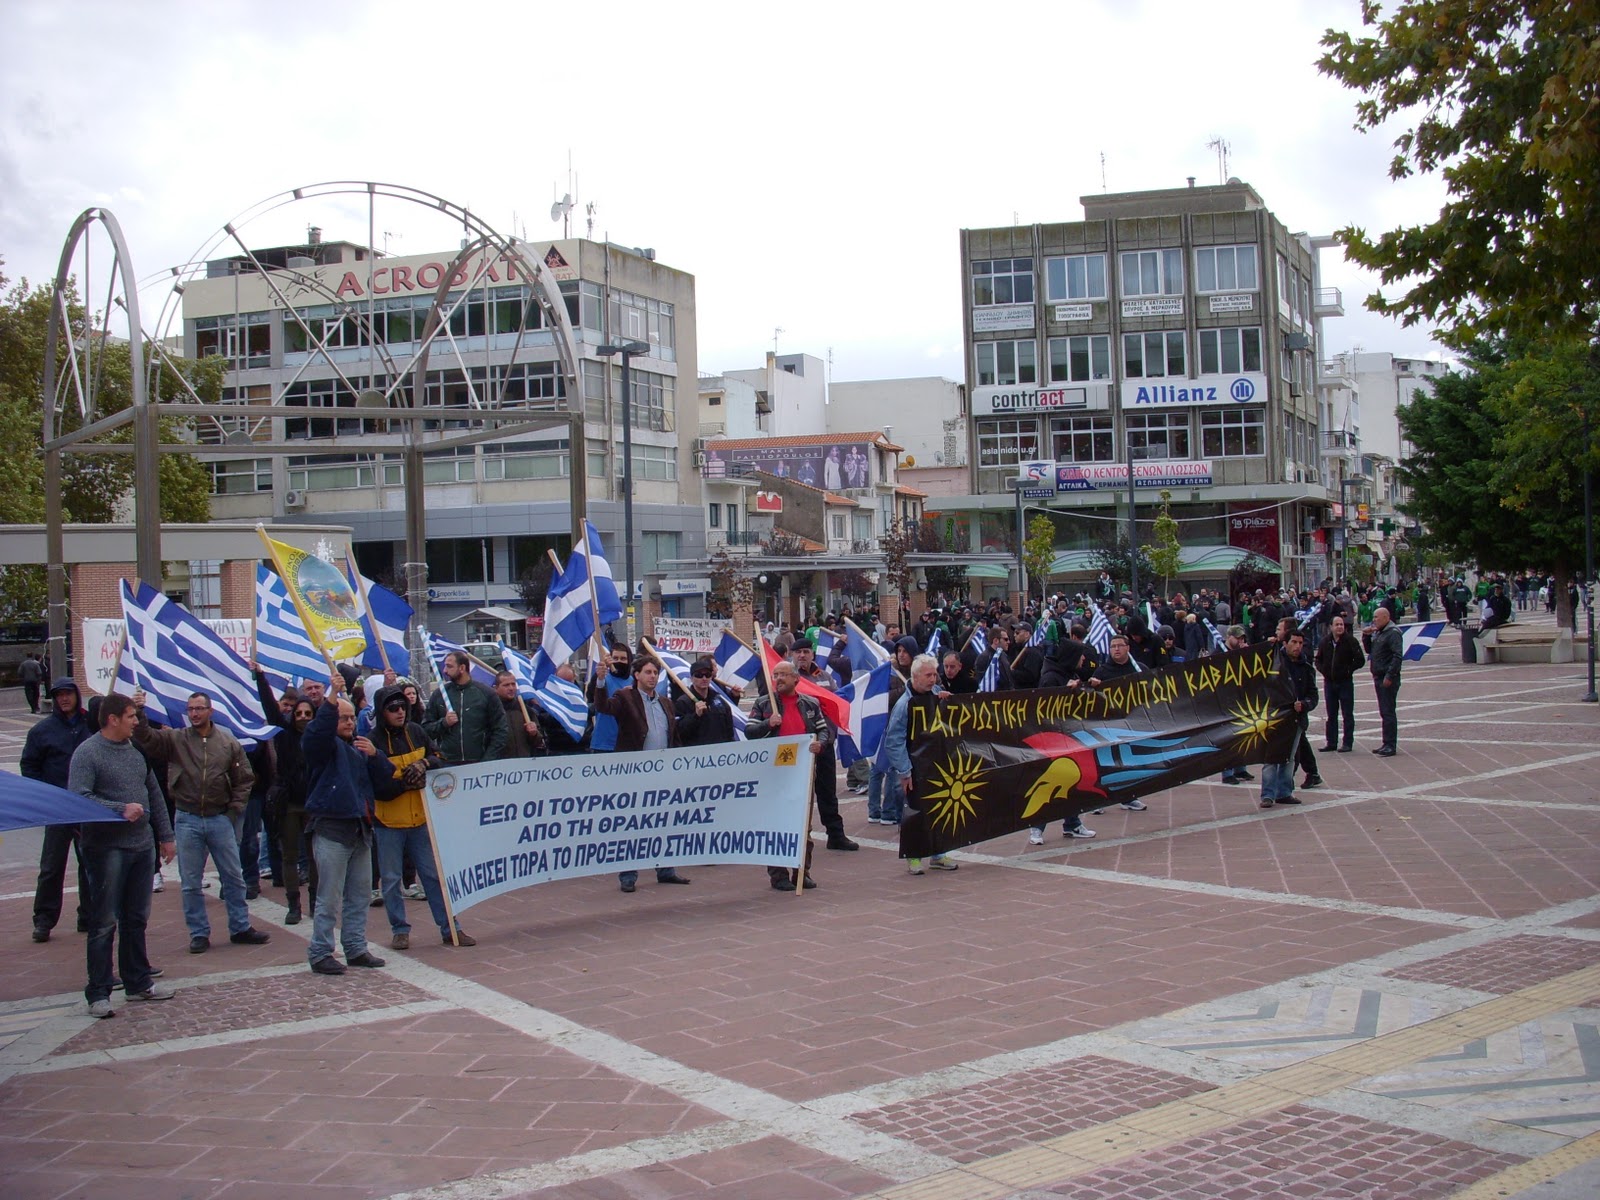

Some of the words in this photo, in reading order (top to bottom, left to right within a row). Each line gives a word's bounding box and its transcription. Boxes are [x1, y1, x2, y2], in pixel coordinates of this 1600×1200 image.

[336, 254, 524, 298] ACROBAT
[1136, 385, 1217, 405] Allianz
[1059, 482, 1087, 490] ΑΓΓΛΙΚΑ
[1093, 466, 1129, 478] ΚΕΝΤΡΟ
[1165, 463, 1208, 475] ΓΛΩΣΣΩΝ
[911, 699, 1029, 741] ΠΑΤΡΙΩΤΙΚΗ
[1037, 690, 1097, 726] ΚΙΝΗΣΗ
[1103, 675, 1179, 718] ΠΟΛΙΤΩΝ
[1184, 648, 1280, 697] ΚΑΒΑΛΑΣ
[479, 802, 518, 826] ΕΞΩ
[522, 799, 544, 819] ΟΙ
[549, 791, 637, 816] ΤΟΥΡΚΟΙ
[641, 780, 759, 808] ΠΡΑΚΤΟΡΕΣ
[517, 821, 562, 845] ΑΠΟ
[567, 818, 594, 838] ΤΗ
[598, 810, 670, 833] ΘΡΑΚΗ
[673, 806, 717, 828] ΜΑΣ
[446, 874, 461, 904] ΝΑ
[459, 857, 508, 898] ΚΛΕΙΣΕΙ
[510, 848, 549, 880] ΤΩΡΑ
[552, 846, 572, 871] ΤΟ
[574, 835, 663, 868] ΠΡΟΞΕΝΕΙΟ
[664, 831, 707, 858] ΣΤΗΝ
[709, 830, 799, 858] ΚΟΜΟΤΗΝΗ
